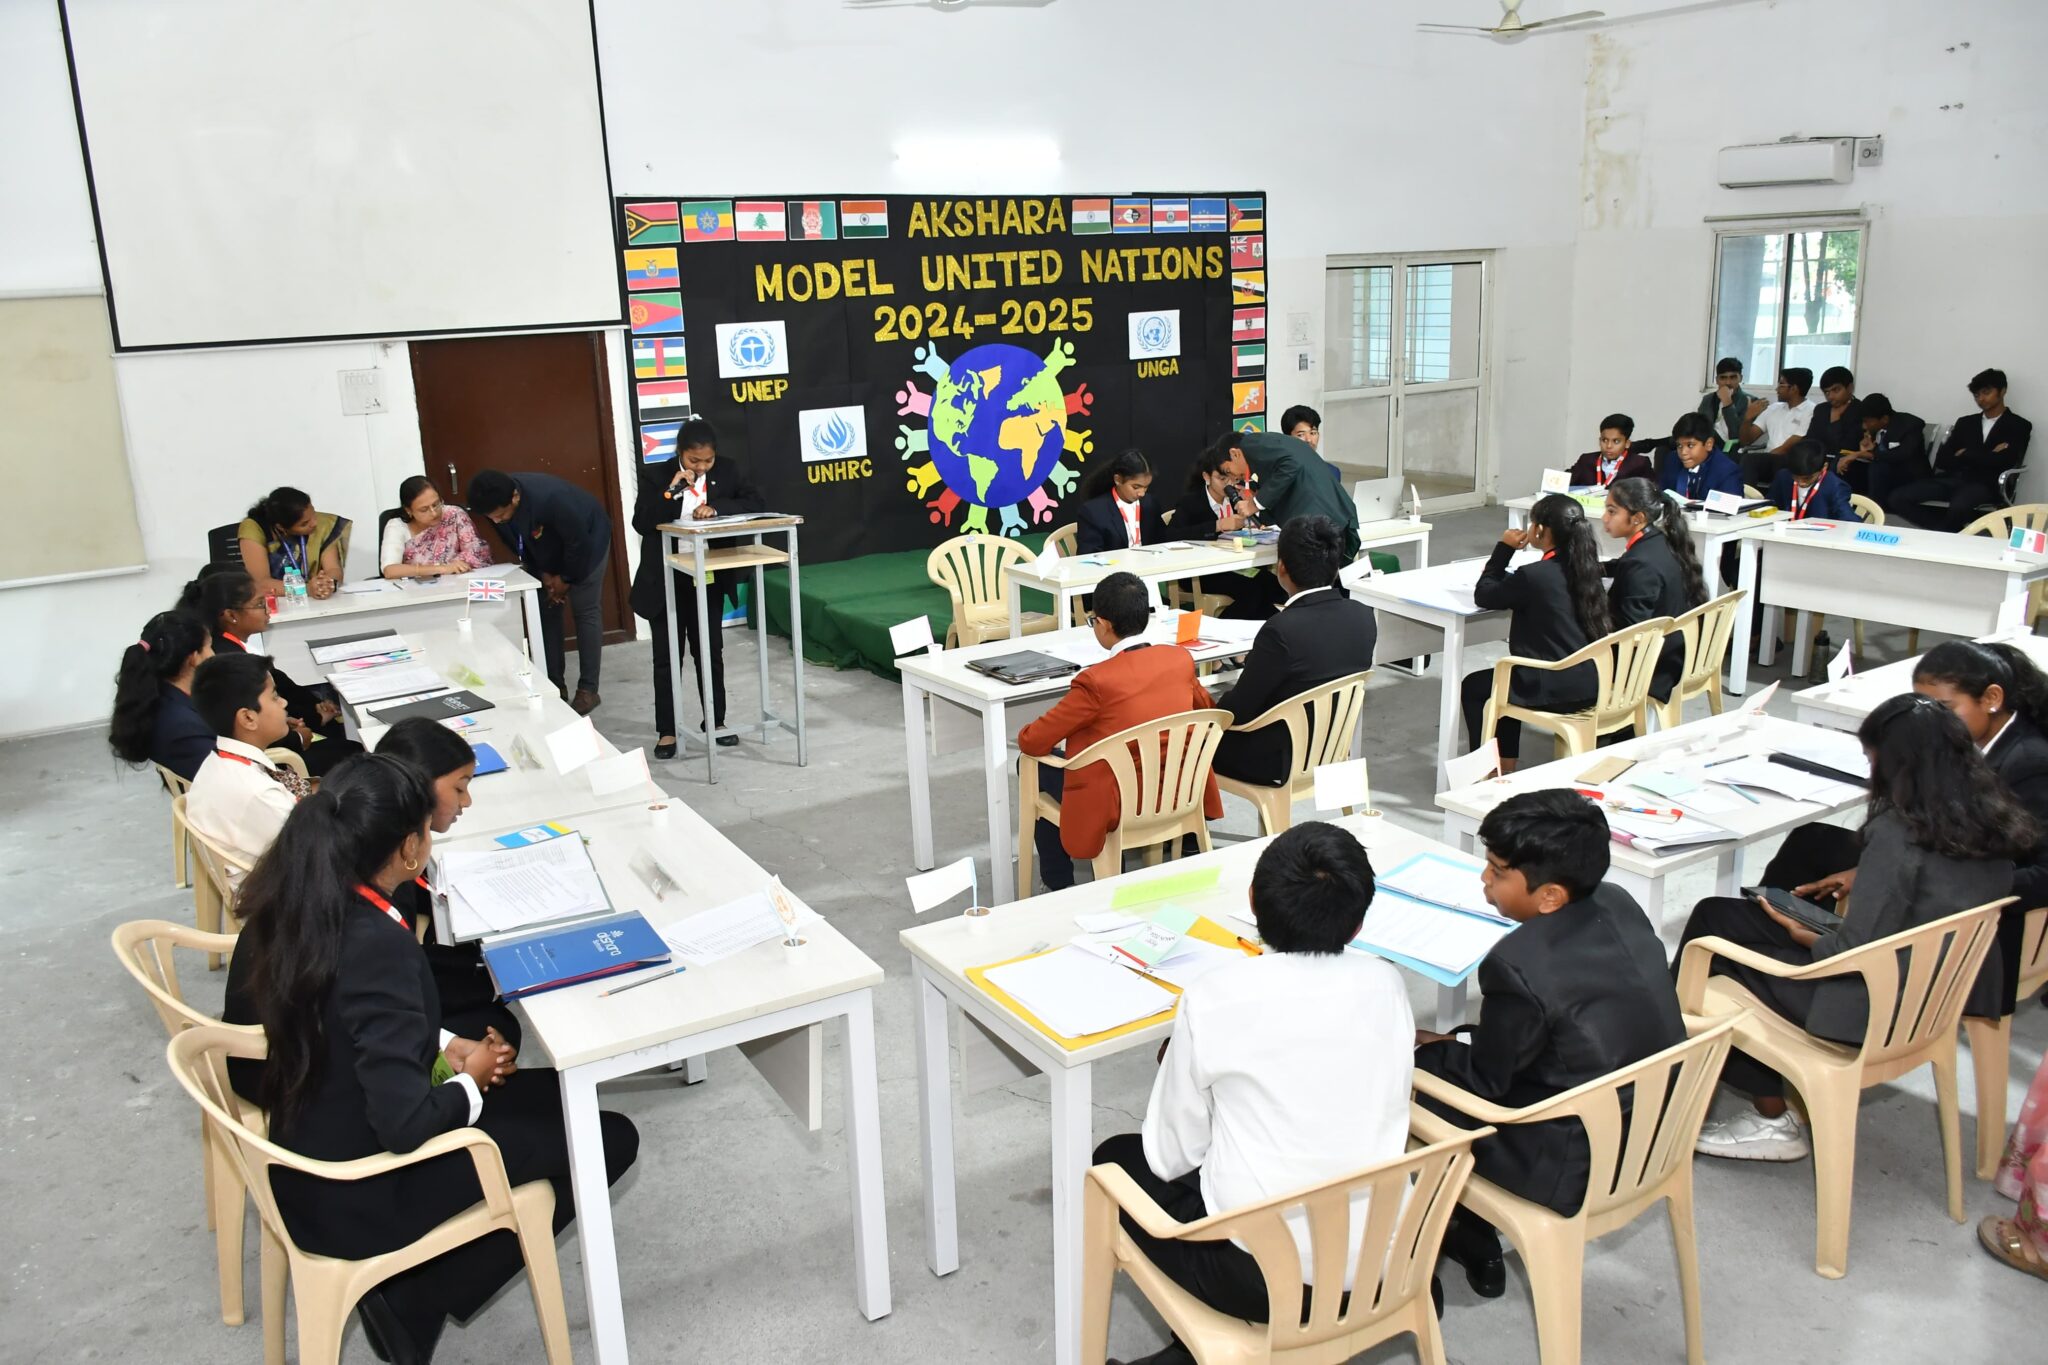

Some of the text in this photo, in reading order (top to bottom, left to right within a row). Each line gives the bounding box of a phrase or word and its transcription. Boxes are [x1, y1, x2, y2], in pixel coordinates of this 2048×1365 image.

[907, 198, 1067, 239] AKSHARA
[755, 246, 1224, 302] MODEL UNITED NATIONS
[874, 297, 1094, 342] 2024-2025
[1137, 358, 1179, 379] UNGA
[731, 379, 789, 403] UNEP
[807, 458, 873, 484] UNHRC
[1857, 531, 1899, 544] MEXICO
